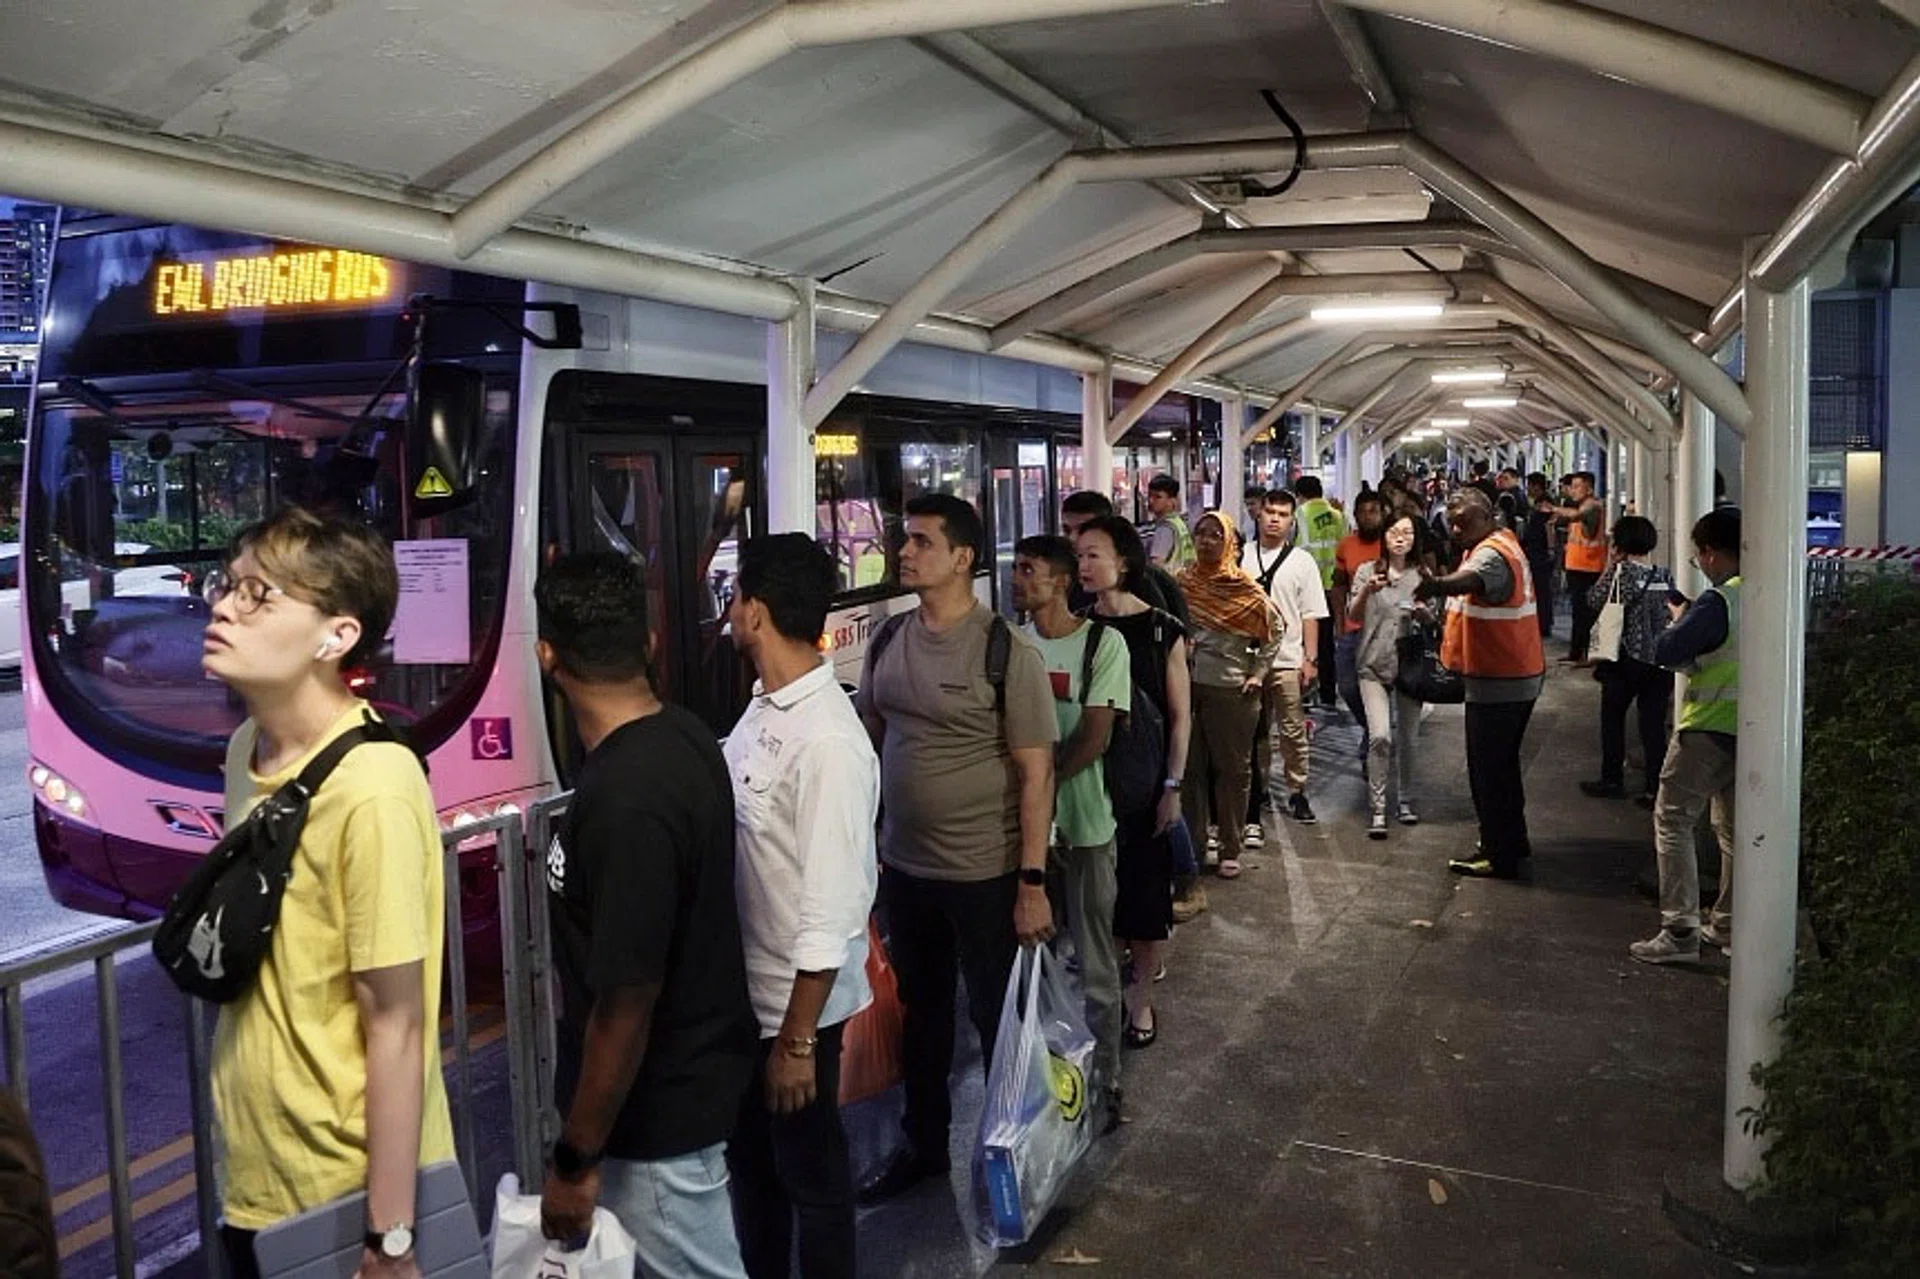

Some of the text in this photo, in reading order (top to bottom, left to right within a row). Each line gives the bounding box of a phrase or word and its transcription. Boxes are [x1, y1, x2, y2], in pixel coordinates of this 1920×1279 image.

[156, 249, 389, 314] EWL BRIDGING BUS
[834, 625, 854, 651] SBS
